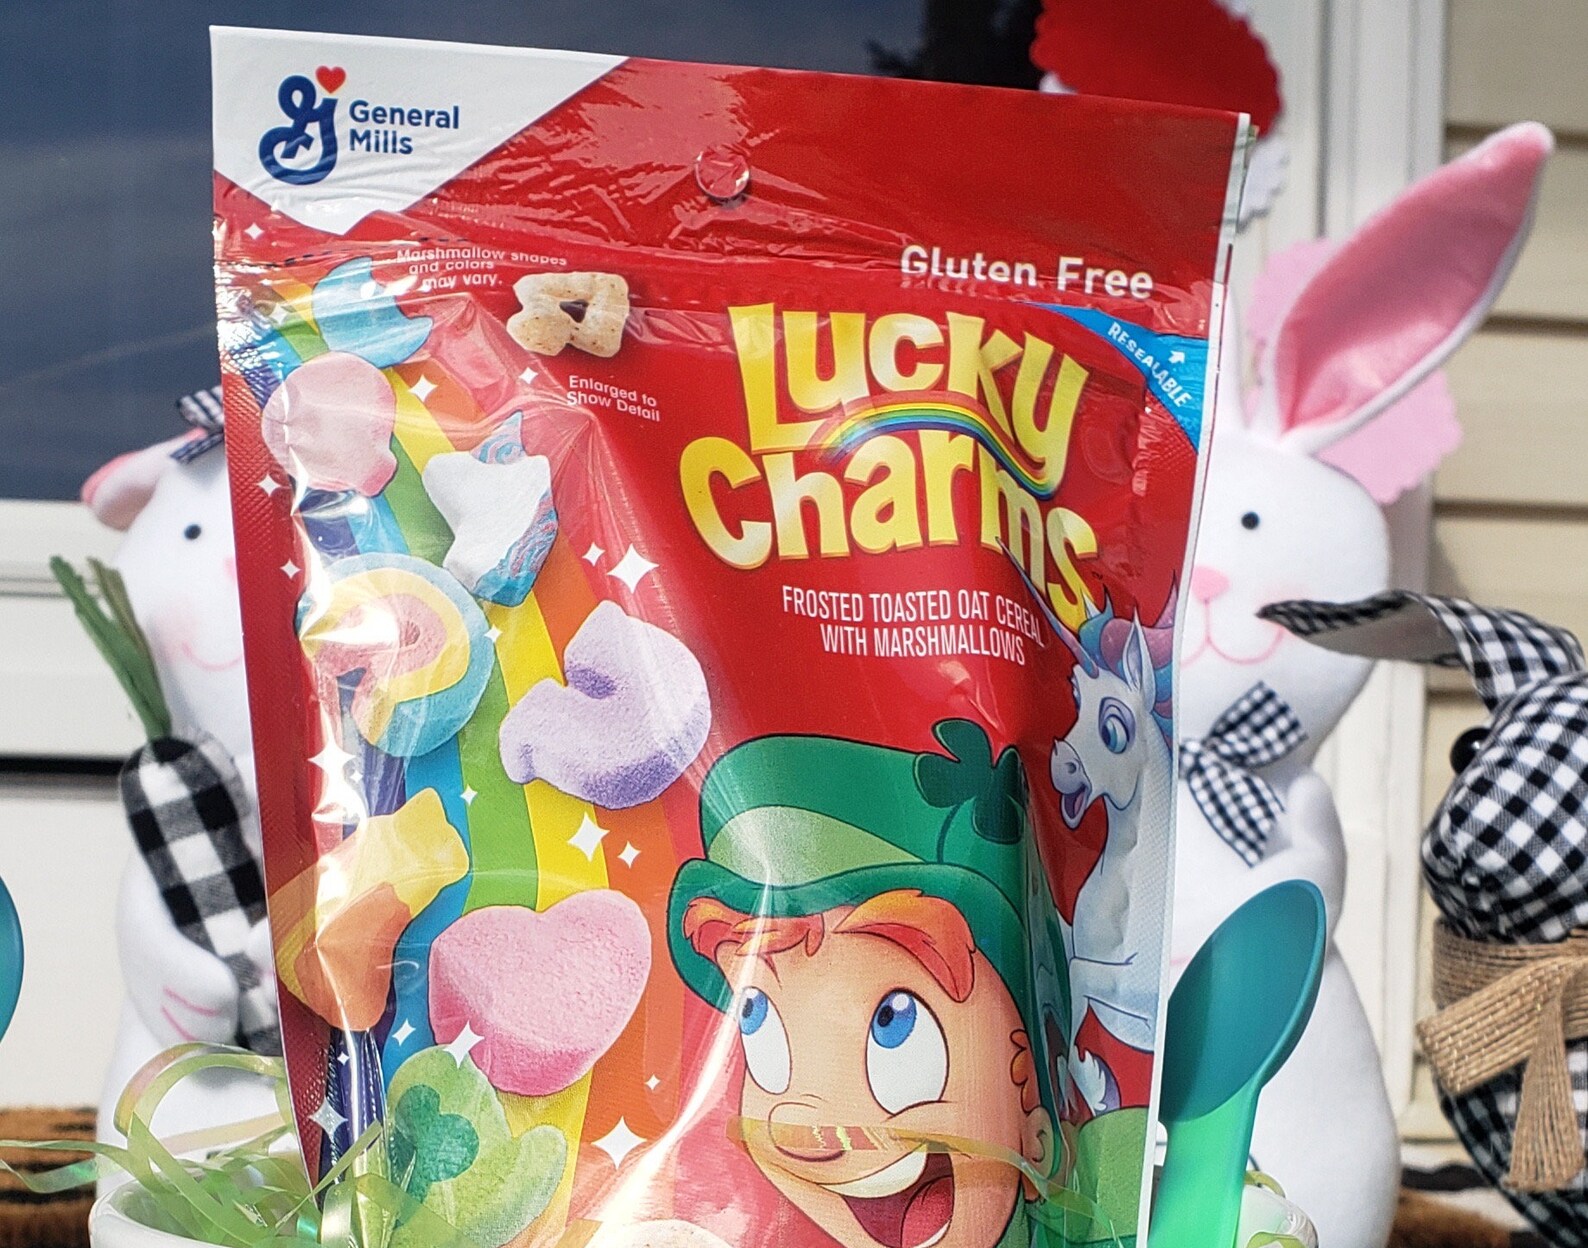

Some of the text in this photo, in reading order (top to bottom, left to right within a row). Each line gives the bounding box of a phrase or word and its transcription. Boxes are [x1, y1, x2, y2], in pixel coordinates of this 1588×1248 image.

[349, 99, 460, 129] General
[350, 128, 413, 155] Mills
[396, 247, 567, 266] Marshmallow shapes
[408, 260, 494, 275] and colors
[899, 244, 1154, 299] Gluten Free
[422, 274, 503, 290] may vary.
[1107, 321, 1193, 408] RESEALABLE
[566, 390, 661, 422] Show Detail
[568, 374, 657, 408] Enlarged to
[727, 302, 1090, 492] Lucky
[679, 430, 1098, 632] Charms
[782, 585, 1045, 648] FROSTED TOASTED OAT CEREAL
[820, 623, 1025, 666] WITH MARSHMALLOWS
